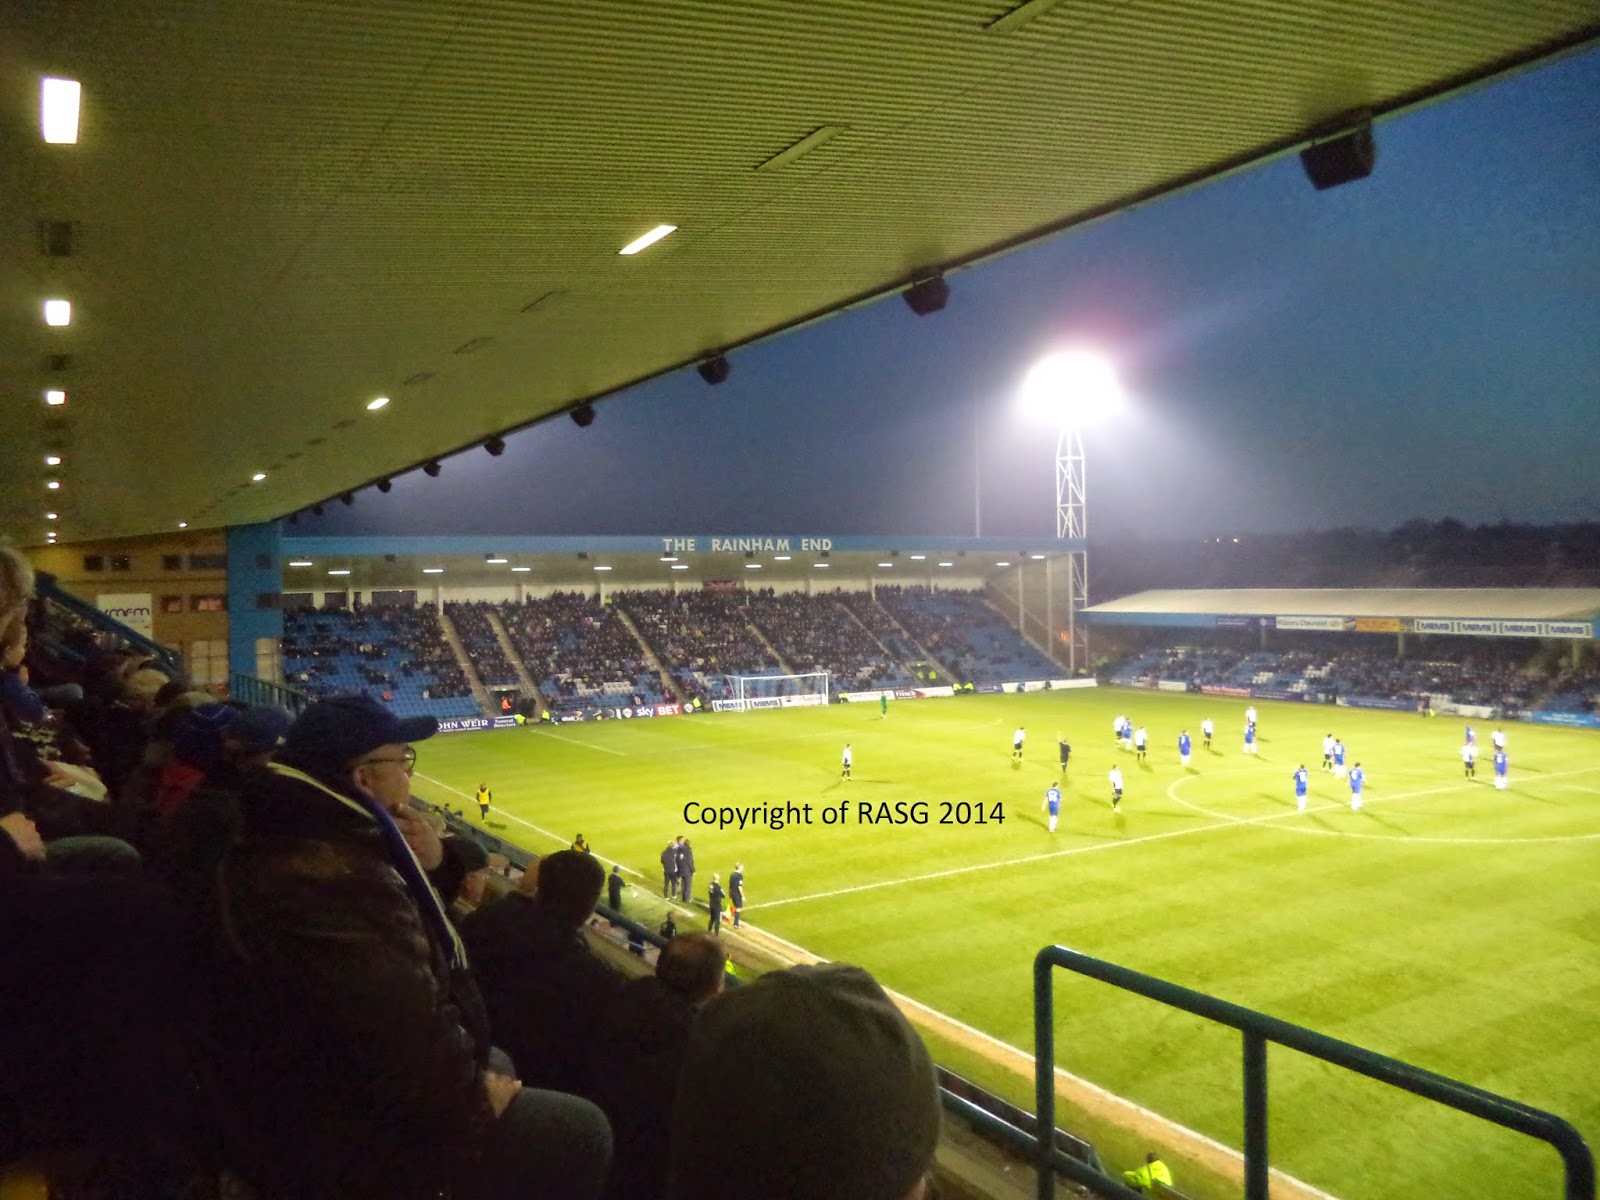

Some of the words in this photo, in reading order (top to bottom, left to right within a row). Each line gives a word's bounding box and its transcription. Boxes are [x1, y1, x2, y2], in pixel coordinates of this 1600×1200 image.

[663, 538, 696, 551] THE
[711, 538, 790, 551] RAINHAM
[801, 538, 832, 551] END
[104, 607, 150, 617] mfm
[636, 706, 654, 718] sky
[657, 704, 680, 716] BET
[438, 721, 458, 730] OHN
[460, 719, 489, 728] WEIR
